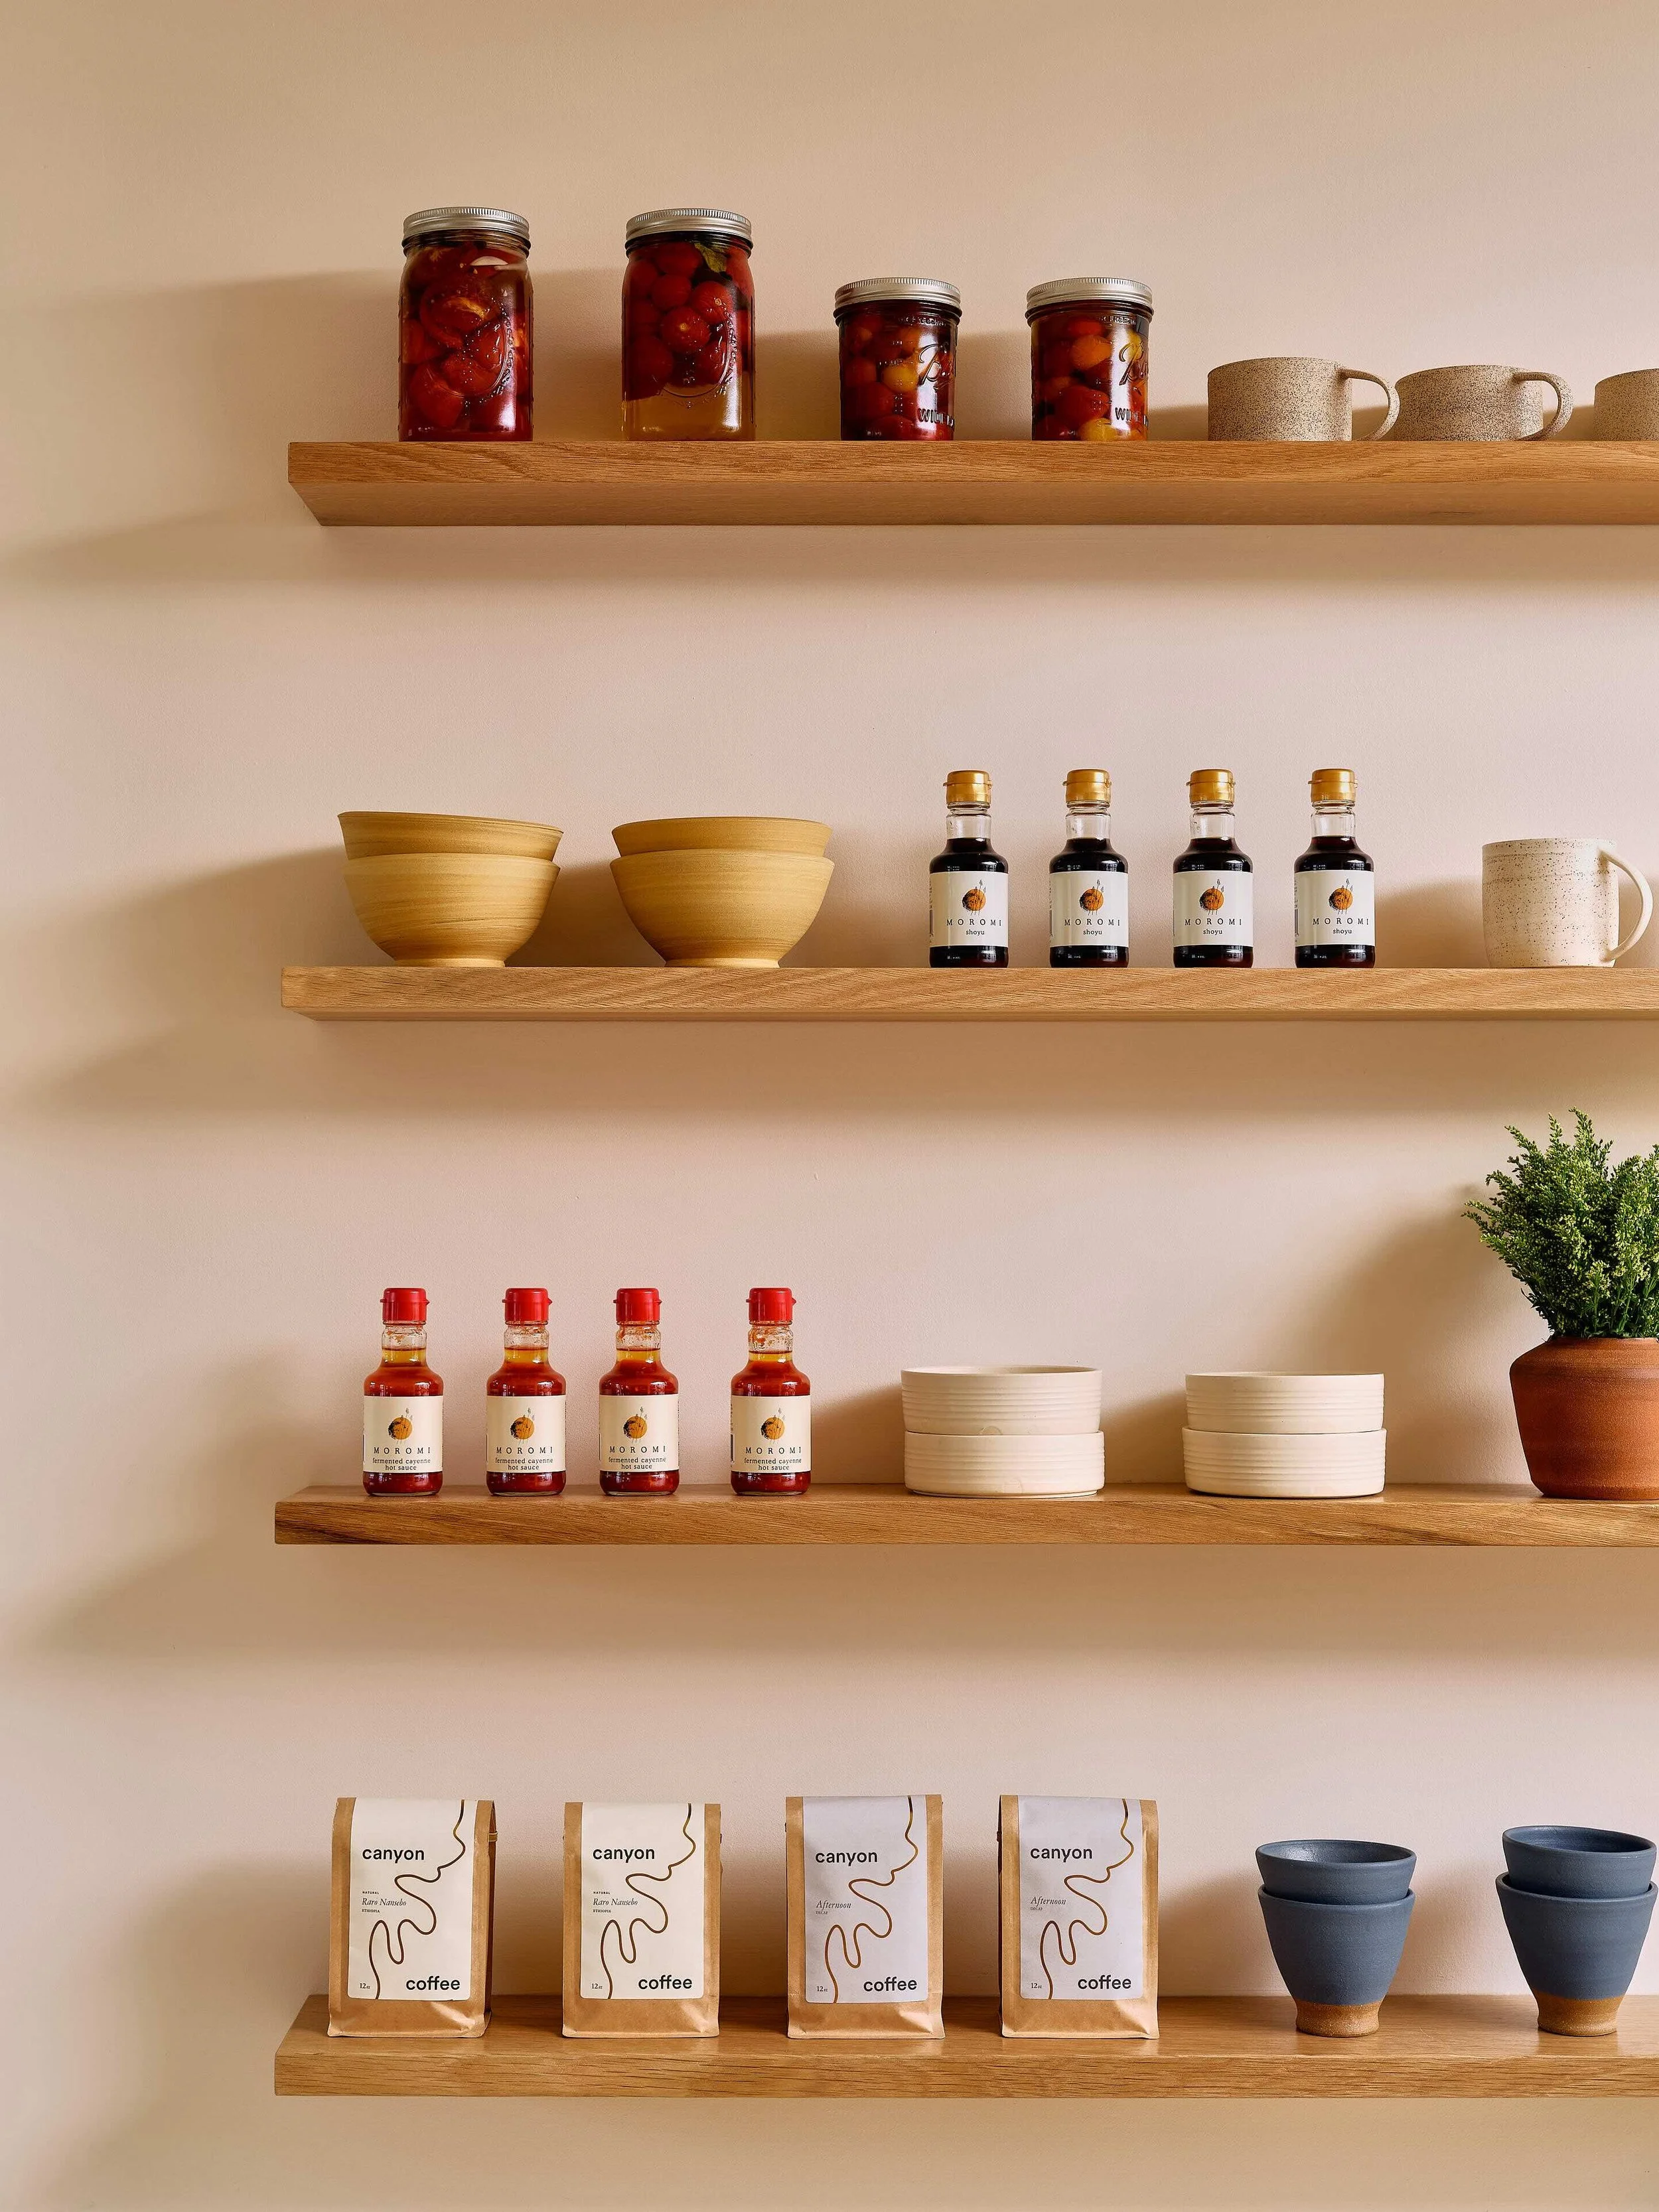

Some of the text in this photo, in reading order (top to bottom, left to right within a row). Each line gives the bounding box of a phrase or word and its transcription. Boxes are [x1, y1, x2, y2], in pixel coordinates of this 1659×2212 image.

[946, 917, 1001, 927] MOROMI
[1064, 917, 1120, 926] MOROMI
[1183, 916, 1242, 926] MOROMI
[1311, 916, 1369, 926] MOROMI
[374, 1446, 431, 1455] MOROMI
[496, 1446, 553, 1456] MOROMI
[609, 1445, 666, 1454] MOROMI
[744, 1445, 801, 1456] MOROMI
[743, 1456, 776, 1465] fermented
[362, 1849, 424, 1864] canyon
[593, 1849, 654, 1863] canyon
[816, 1852, 877, 1866] canyon
[1031, 1848, 1092, 1862] canyon
[379, 1898, 407, 1906] Nansebo
[593, 1898, 638, 1906] Raro Nansebo
[815, 1900, 851, 1911] Afternoon
[1030, 1896, 1066, 1907] Afternoon
[406, 1976, 460, 1990] coffee
[638, 1974, 692, 1989] coffee
[864, 1976, 917, 1992] coffee
[1078, 1974, 1131, 1989] coffee
